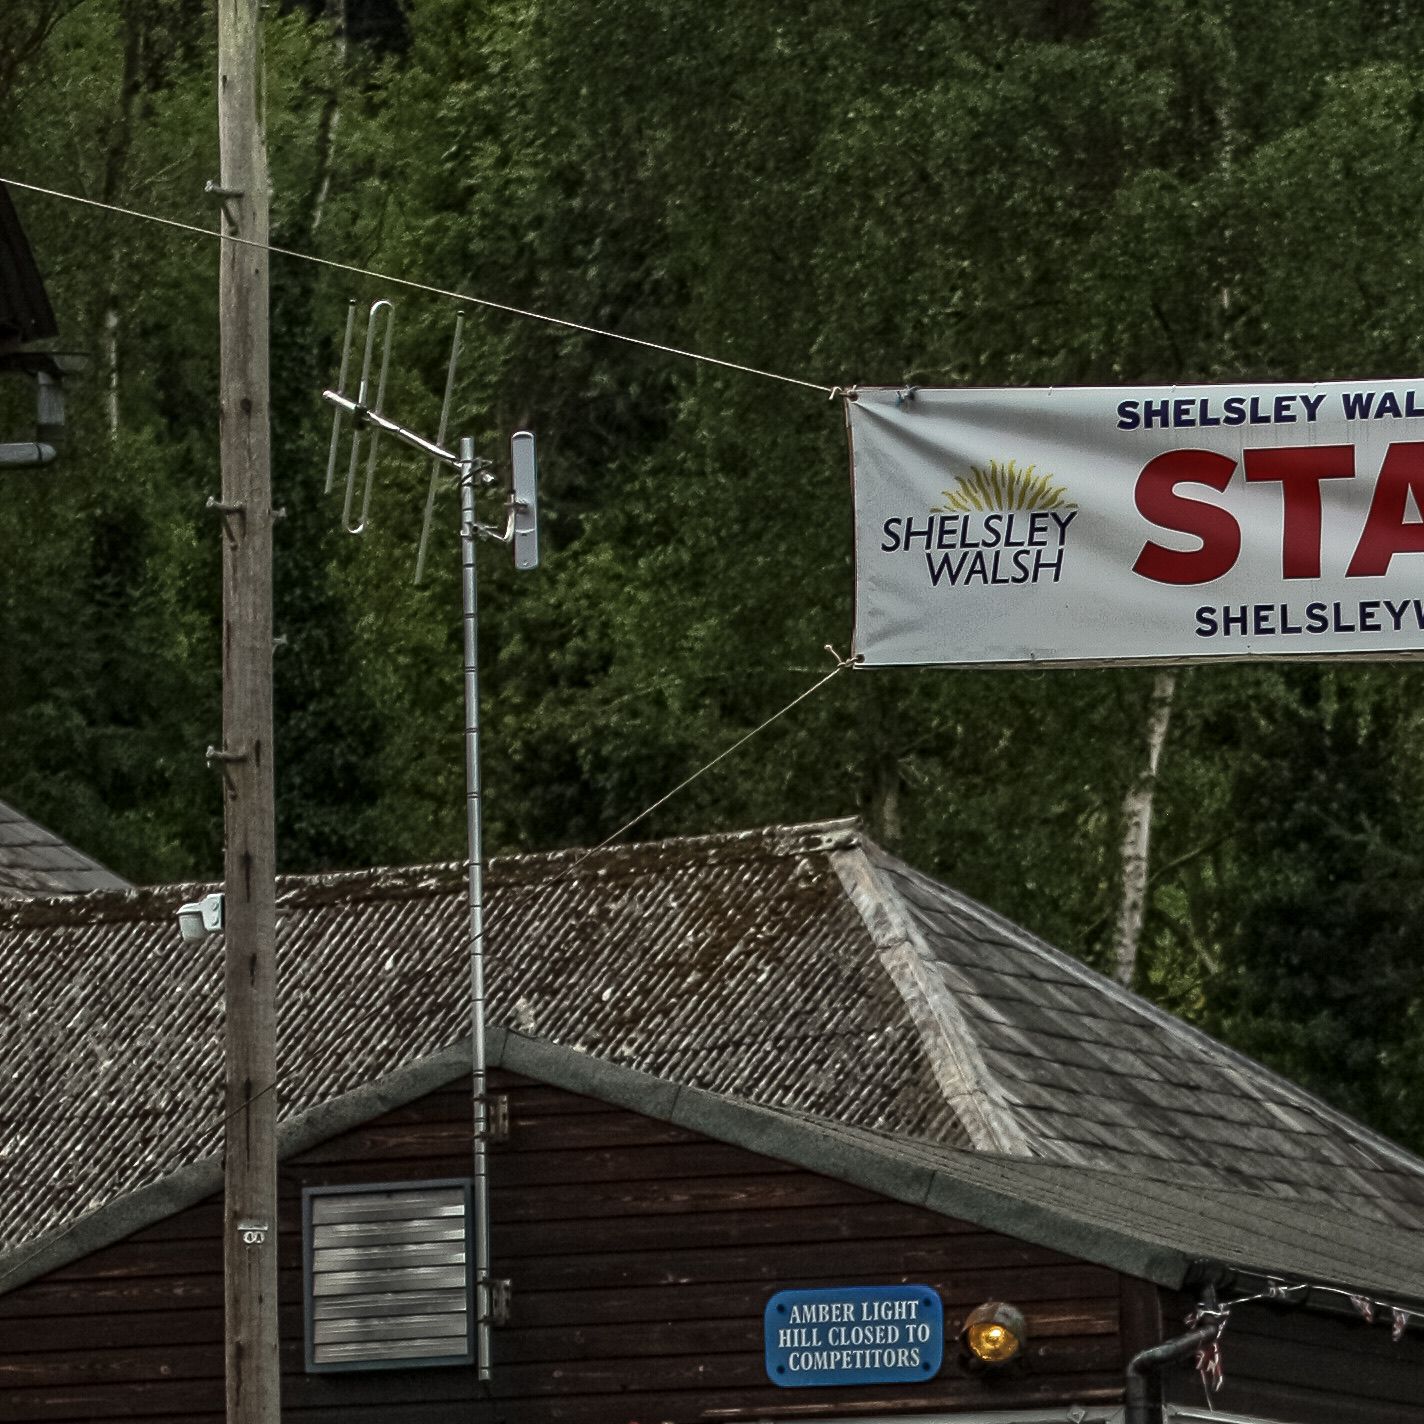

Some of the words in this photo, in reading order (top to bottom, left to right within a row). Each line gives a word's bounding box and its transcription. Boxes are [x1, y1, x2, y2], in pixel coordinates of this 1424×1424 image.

[1116, 393, 1326, 430] SHELSLEY
[881, 510, 1079, 553] SHELSLEY
[926, 547, 1064, 588] WALSH
[789, 1303, 855, 1324] AMBER
[861, 1300, 919, 1322] LIGHT
[778, 1327, 822, 1348] HILL
[828, 1324, 900, 1346] CLOSED
[905, 1323, 930, 1343] TO
[788, 1347, 921, 1372] COMPETITORS
